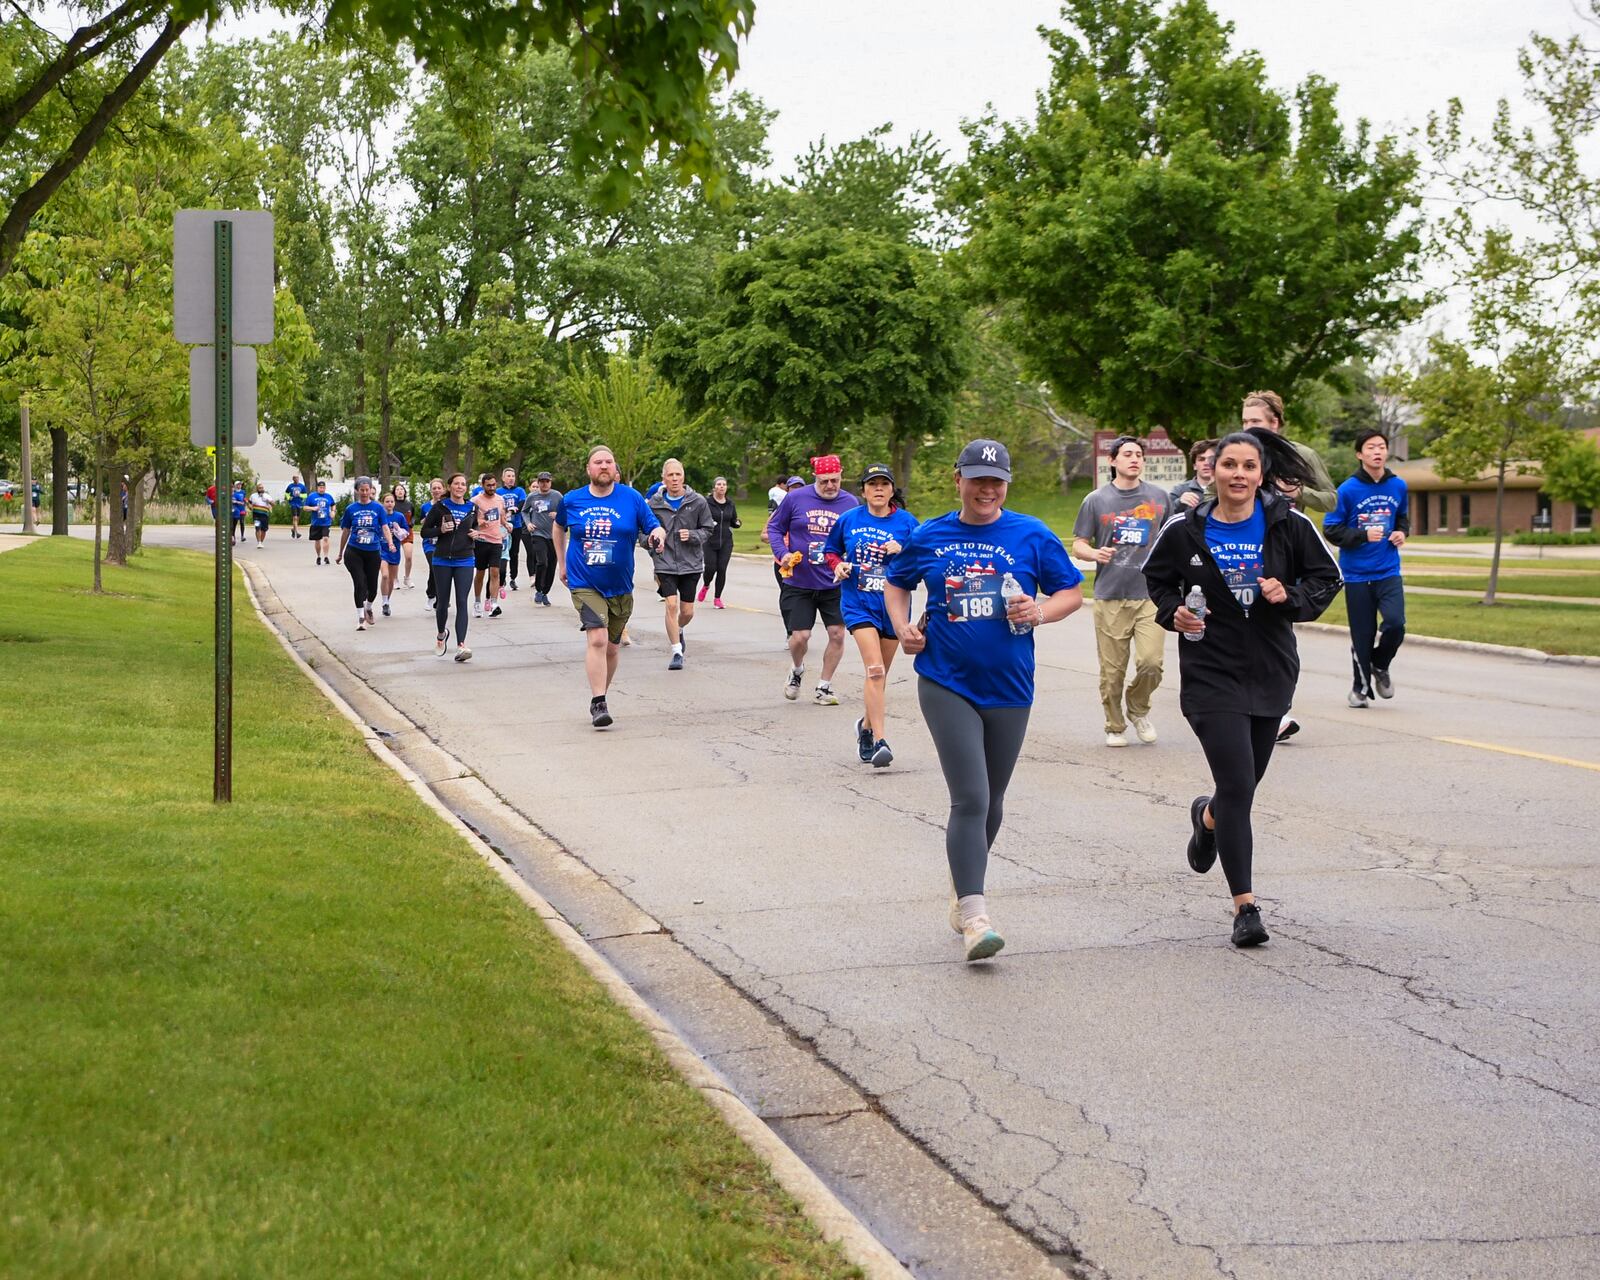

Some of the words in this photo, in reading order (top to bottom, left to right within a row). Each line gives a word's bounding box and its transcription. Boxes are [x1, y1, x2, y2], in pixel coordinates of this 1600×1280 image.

[982, 446, 997, 462] NY
[1144, 457, 1185, 465] ULATIONS
[851, 527, 867, 536] RACE
[1223, 543, 1236, 551] TO
[1238, 543, 1256, 551] THE
[588, 553, 606, 564] 275
[935, 543, 960, 558] RACE
[977, 543, 995, 551] THE
[995, 546, 1016, 565] FLAG
[1230, 588, 1254, 606] 70
[960, 597, 993, 617] 198
